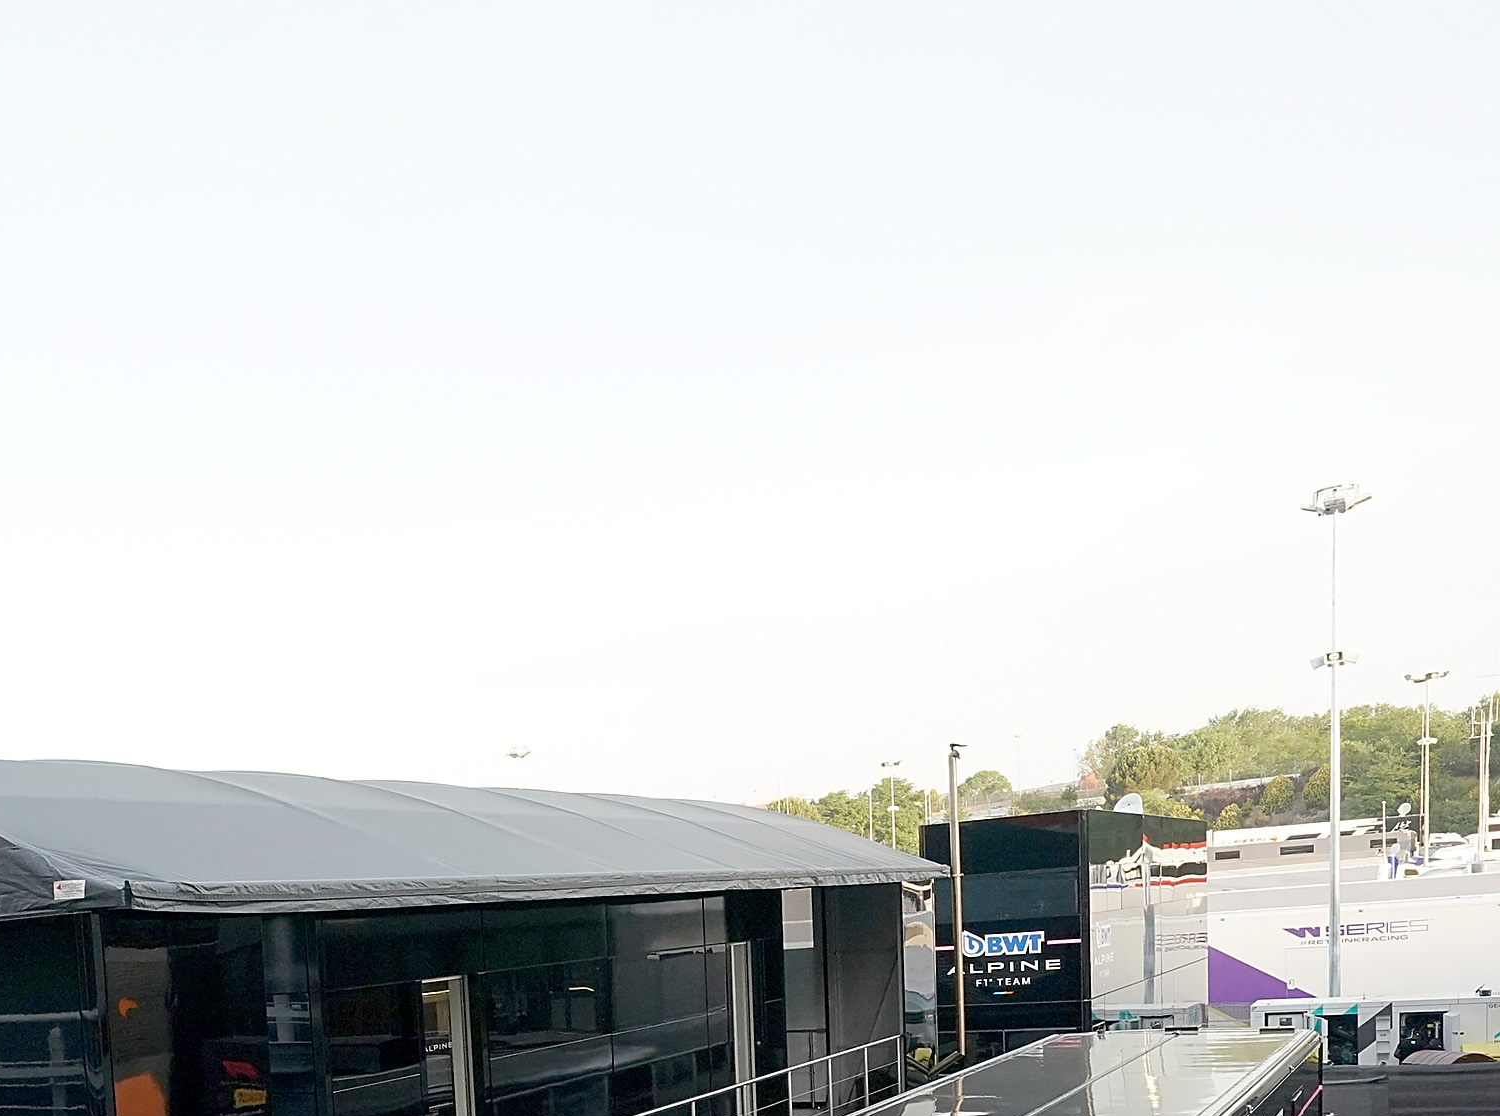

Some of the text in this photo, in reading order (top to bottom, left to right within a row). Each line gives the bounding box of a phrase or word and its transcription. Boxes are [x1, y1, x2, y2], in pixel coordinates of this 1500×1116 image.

[984, 930, 1045, 957] BWT
[1300, 934, 1409, 946] #RETINKRACING
[946, 958, 1061, 976] ALPINE
[997, 976, 1032, 987] TEAM
